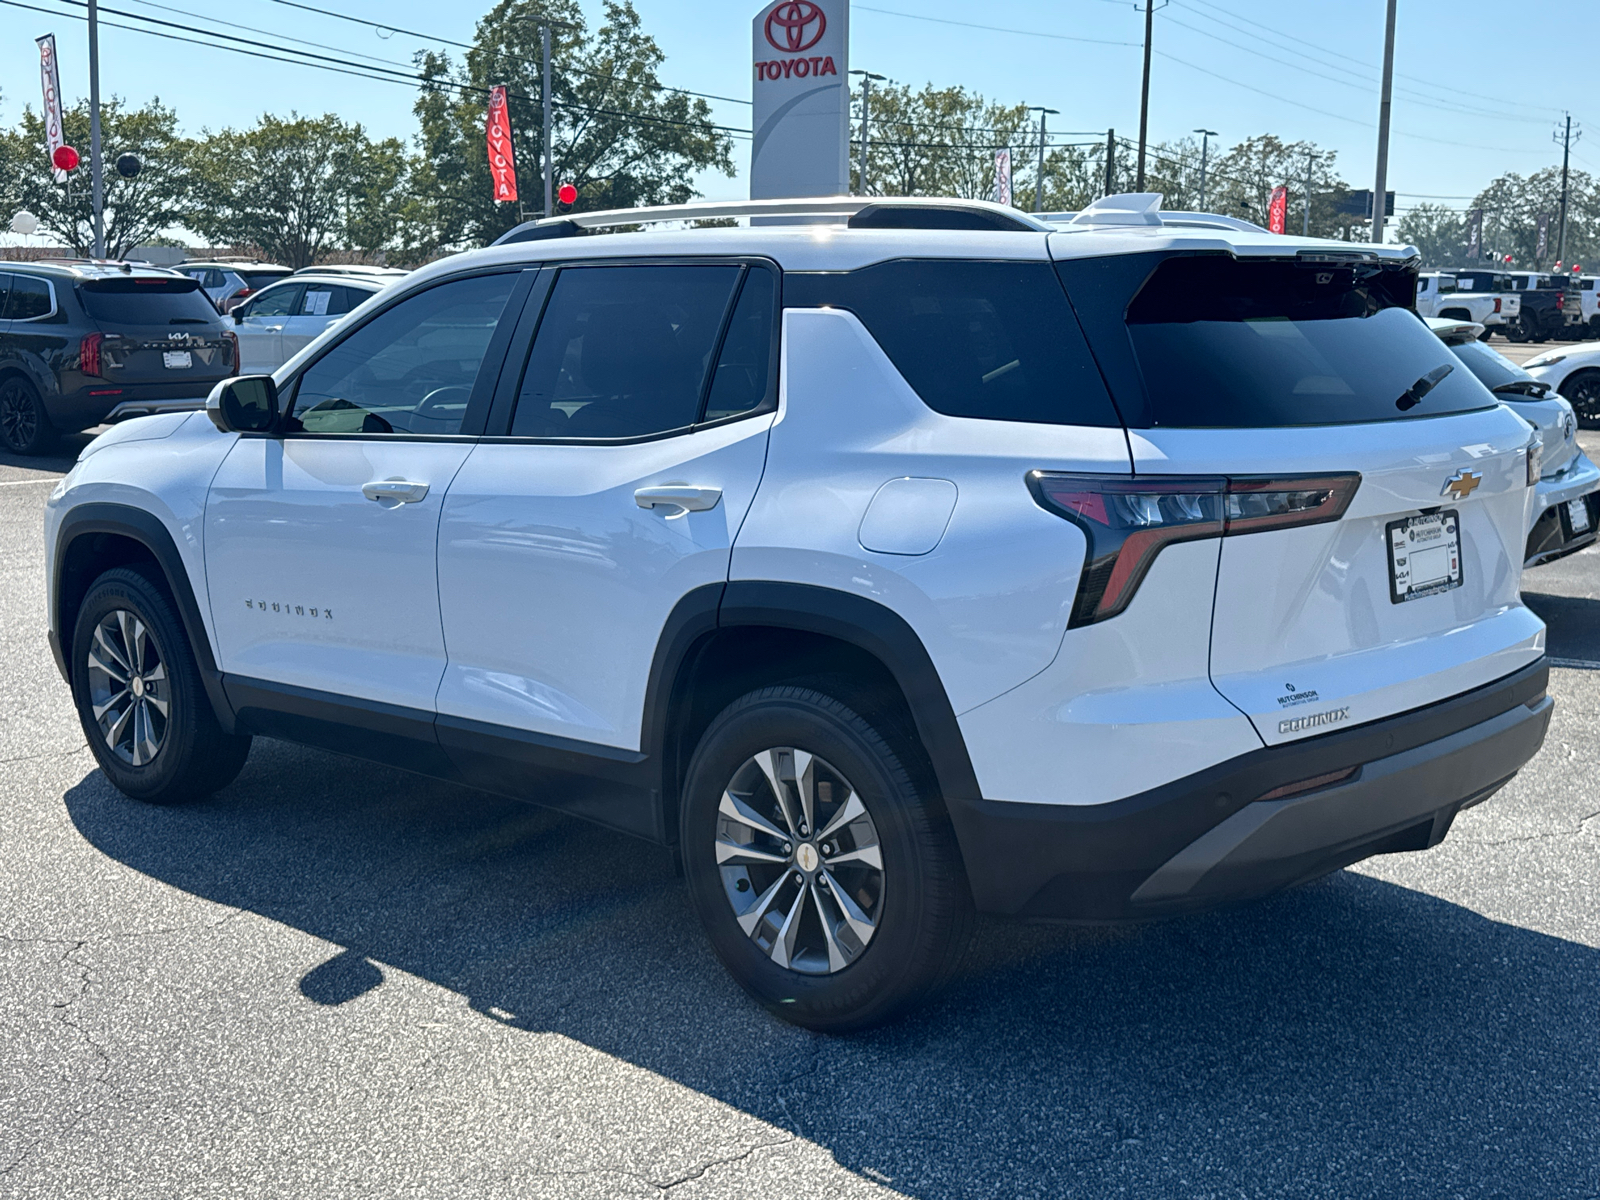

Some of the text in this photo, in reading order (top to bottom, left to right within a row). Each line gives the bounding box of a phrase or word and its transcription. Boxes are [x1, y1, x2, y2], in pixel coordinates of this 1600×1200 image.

[755, 56, 837, 81] TOYOTA
[491, 110, 510, 196] TOYOTA
[168, 332, 190, 340] KIA
[245, 598, 333, 619] EQUINOX
[1277, 689, 1319, 704] HUTCHINSON
[1278, 705, 1350, 734] EQUINOX
